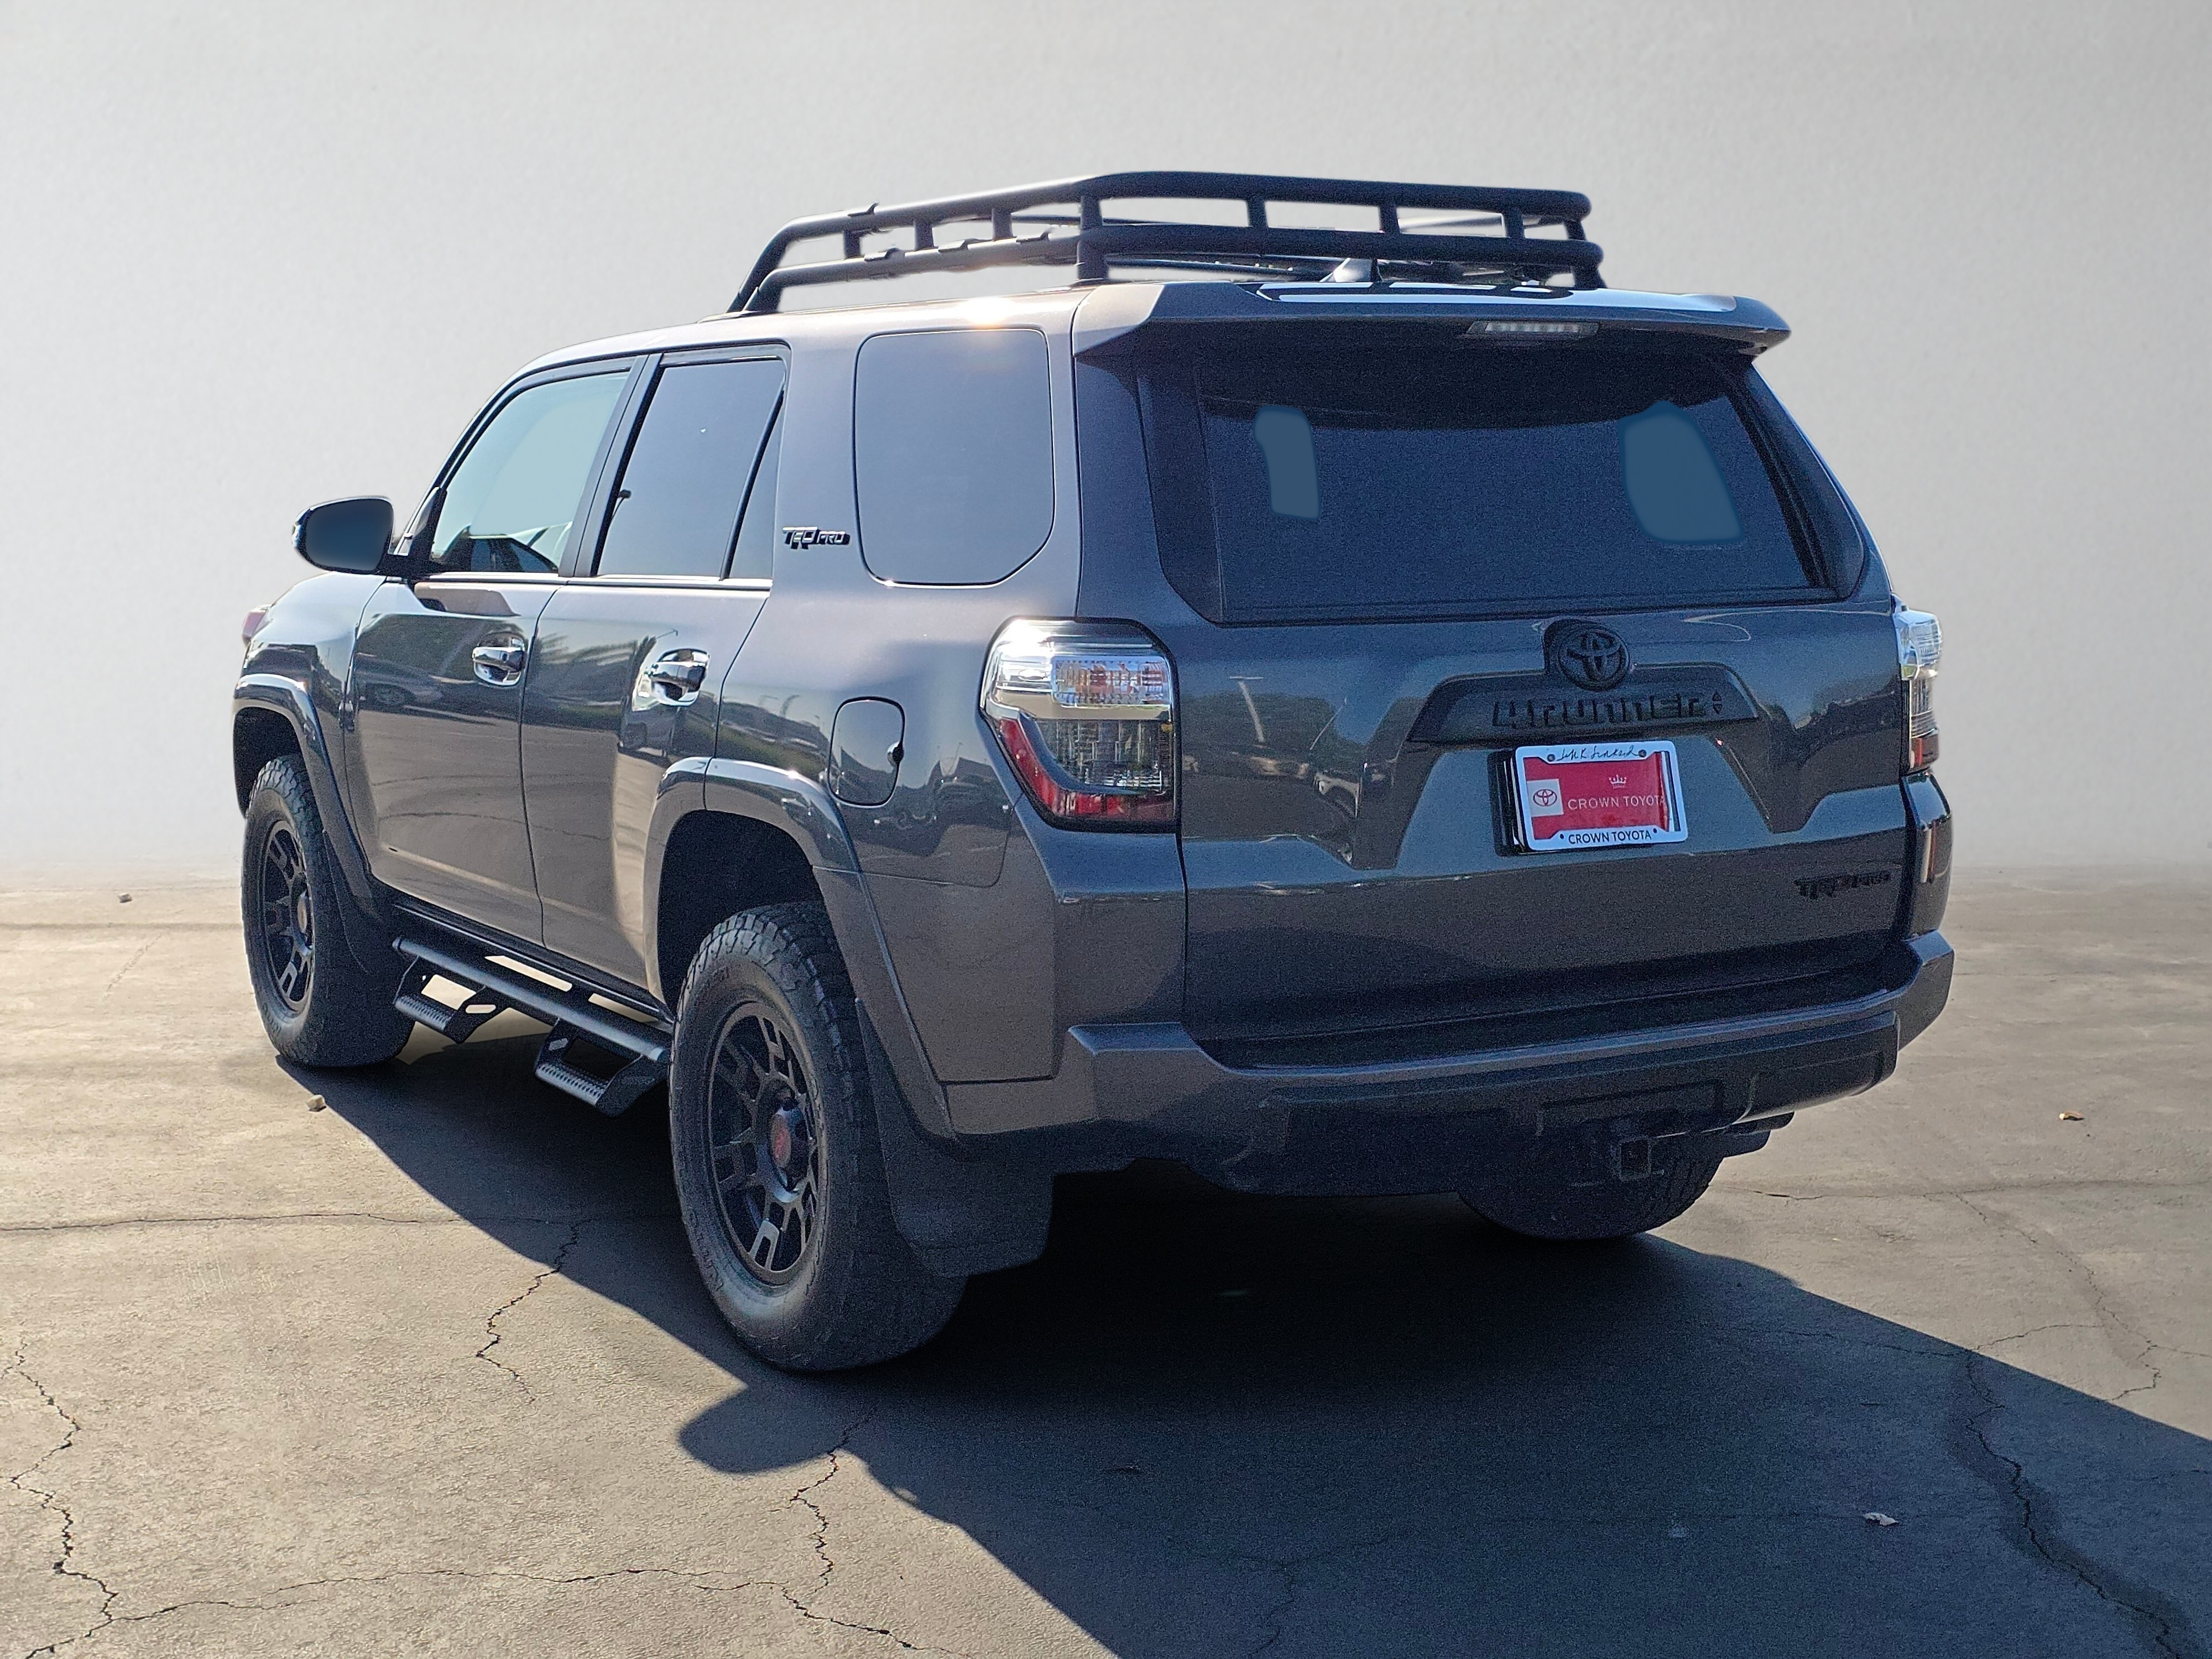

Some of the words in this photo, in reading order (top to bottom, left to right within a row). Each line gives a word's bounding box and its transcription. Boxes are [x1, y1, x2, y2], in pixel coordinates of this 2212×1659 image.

[1567, 795, 1619, 811] CROWN
[1568, 832, 1610, 844] CROWN
[1613, 830, 1652, 842] TOYOTA
